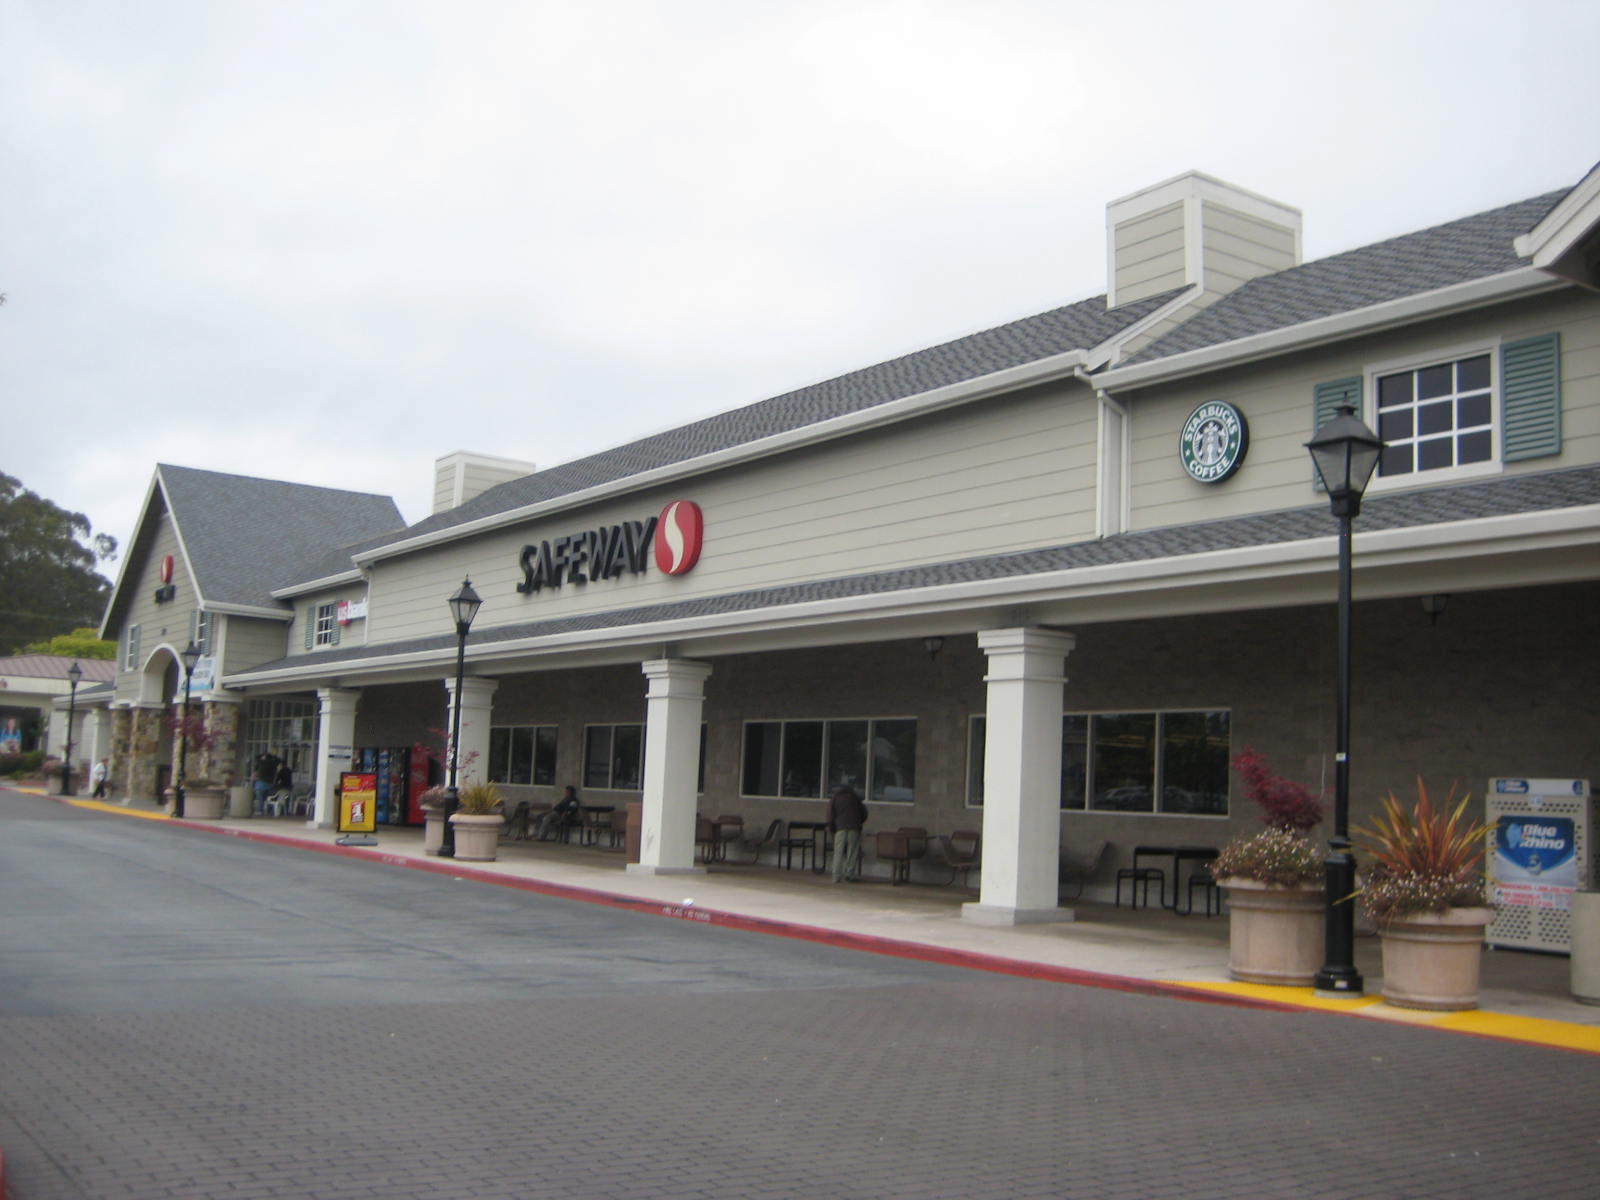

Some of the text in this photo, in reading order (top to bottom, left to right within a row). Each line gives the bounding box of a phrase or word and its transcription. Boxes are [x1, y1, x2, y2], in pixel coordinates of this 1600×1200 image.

[1184, 405, 1238, 442] STARBUCKS
[1189, 456, 1231, 478] COFFEE
[517, 516, 658, 594] SAFEWAY
